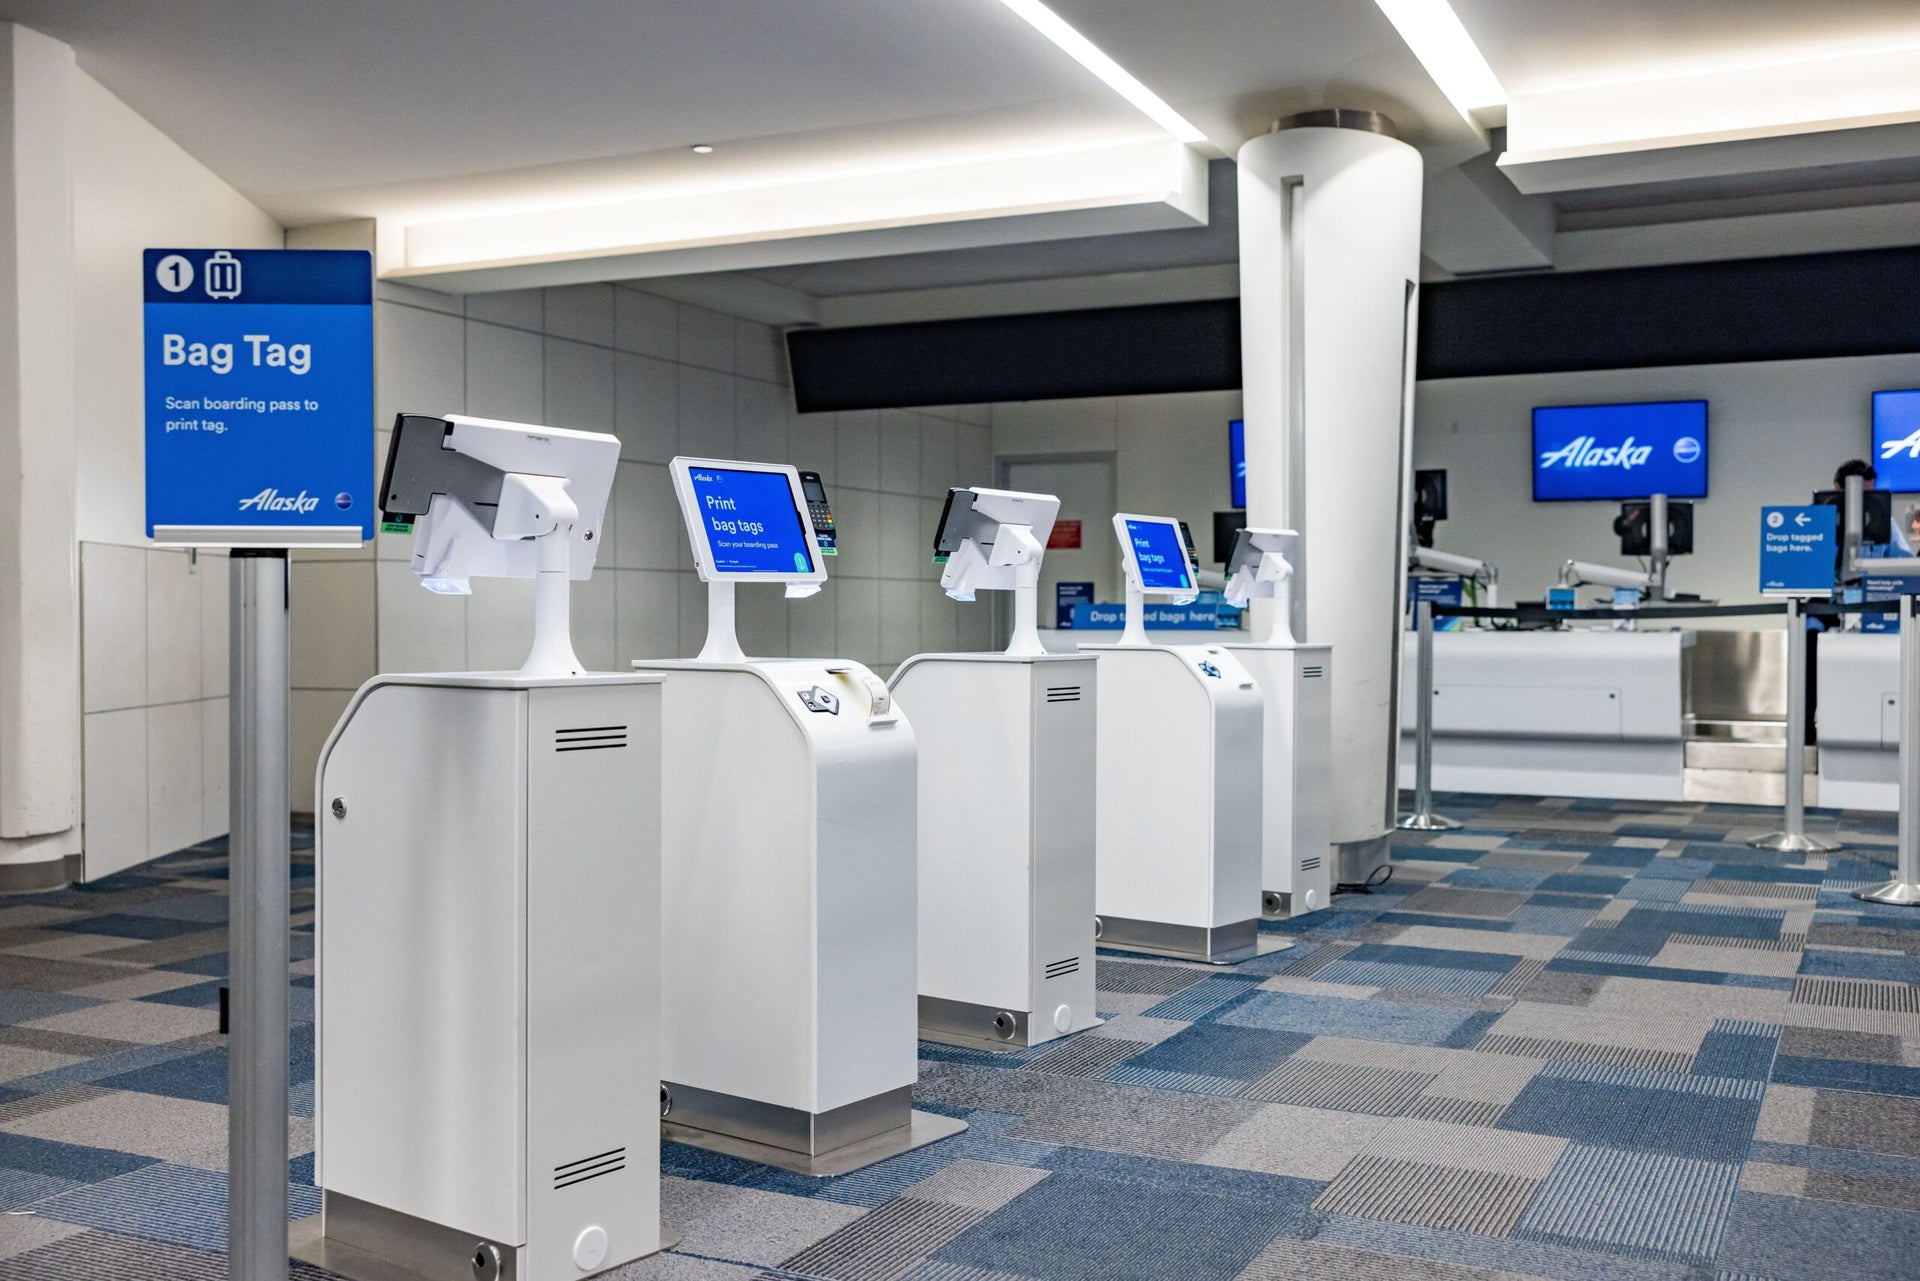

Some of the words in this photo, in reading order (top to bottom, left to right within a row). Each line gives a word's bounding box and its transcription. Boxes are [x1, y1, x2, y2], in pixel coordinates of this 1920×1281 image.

[168, 262, 181, 287] 1
[163, 334, 233, 374] Bag
[243, 335, 311, 375] Tag
[165, 397, 200, 410] Scan
[203, 398, 266, 413] boarding
[269, 400, 301, 412] pass
[304, 400, 319, 411] to
[165, 418, 199, 433] print
[201, 419, 228, 434] tag.
[1540, 436, 1653, 470] Alaska
[238, 488, 320, 514] Alaska
[706, 495, 737, 511] Print
[711, 516, 737, 535] bag
[737, 519, 764, 535] tags
[717, 540, 732, 548] Scan
[743, 541, 767, 550] boarding
[1134, 538, 1150, 548] Print
[1766, 533, 1789, 542] Drop
[1791, 533, 1824, 543] tagged
[1766, 543, 1788, 554] bags
[1789, 544, 1813, 552] here.
[1138, 552, 1151, 564] bag
[1151, 554, 1165, 565] tags
[1091, 611, 1117, 623] Drop
[1160, 611, 1186, 624] bags
[1189, 611, 1215, 621] here
